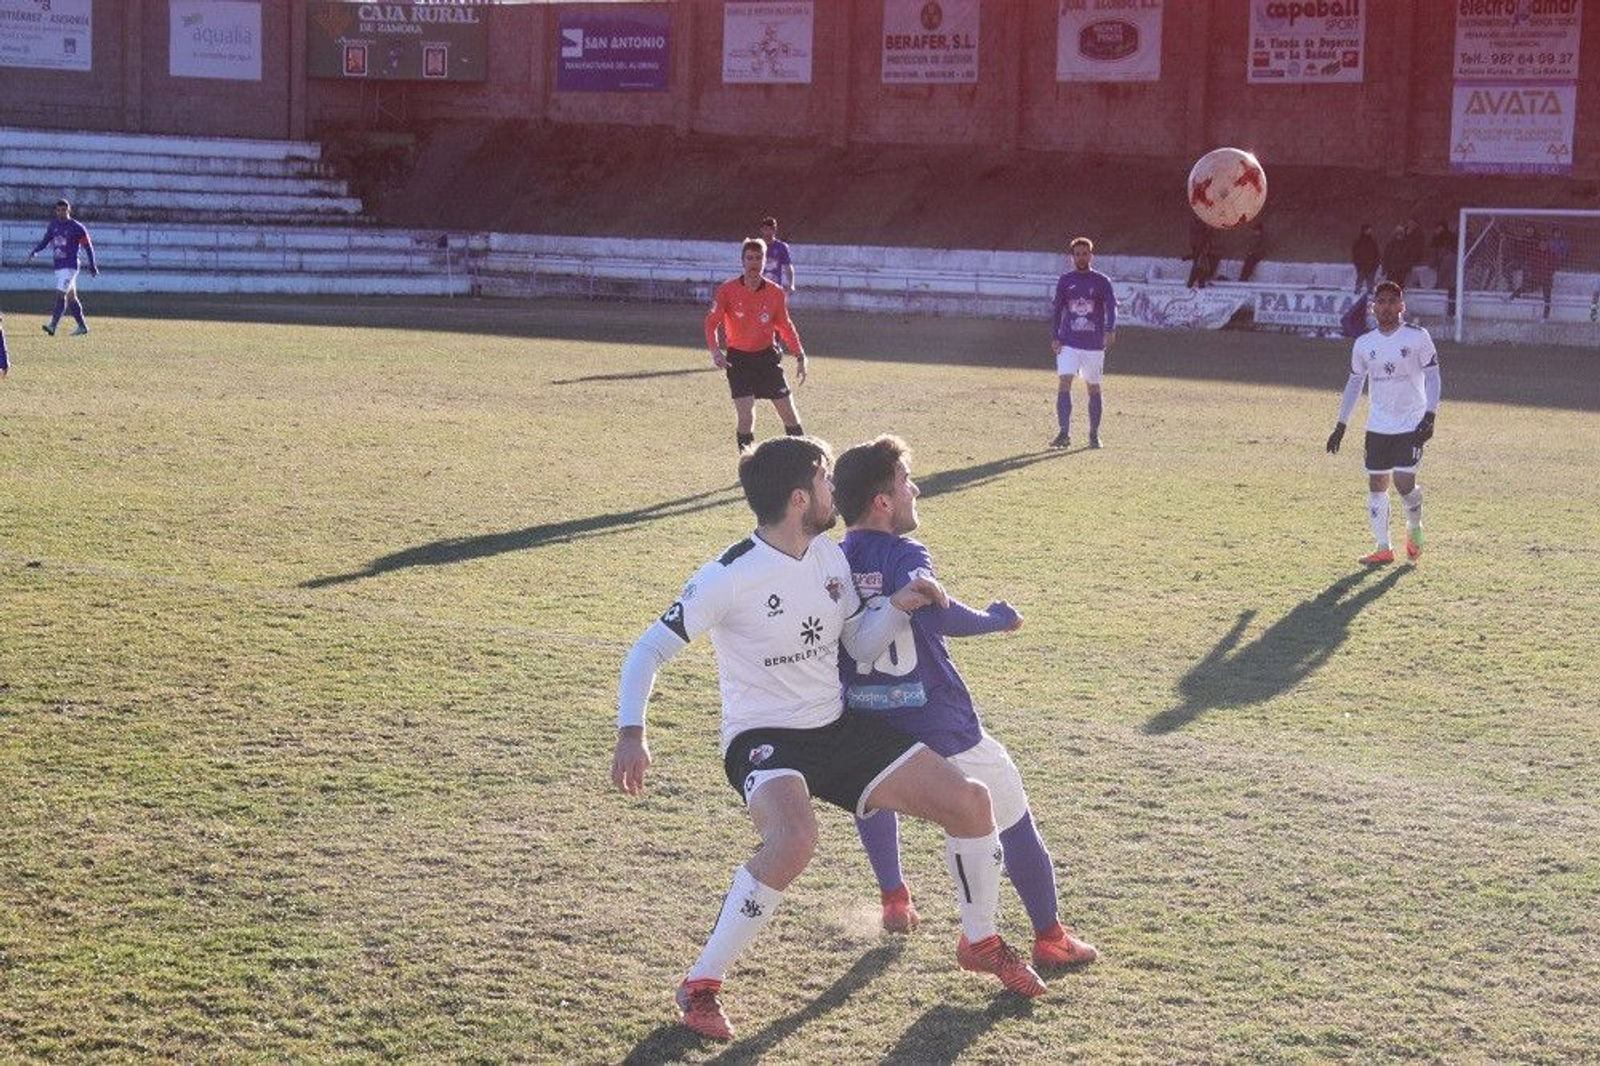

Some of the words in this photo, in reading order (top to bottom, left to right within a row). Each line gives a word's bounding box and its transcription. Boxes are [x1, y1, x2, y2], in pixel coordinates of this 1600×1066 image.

[358, 4, 407, 22] CAJA
[411, 5, 480, 24] RURAL
[192, 26, 253, 46] aqualia
[358, 23, 374, 33] DE
[584, 36, 608, 50] SAN
[610, 35, 666, 50] ANTONIO
[885, 34, 950, 51] BERAFER,
[952, 33, 976, 50] S.L.
[1463, 89, 1563, 115] AVATA
[764, 649, 818, 667] BERKELEY
